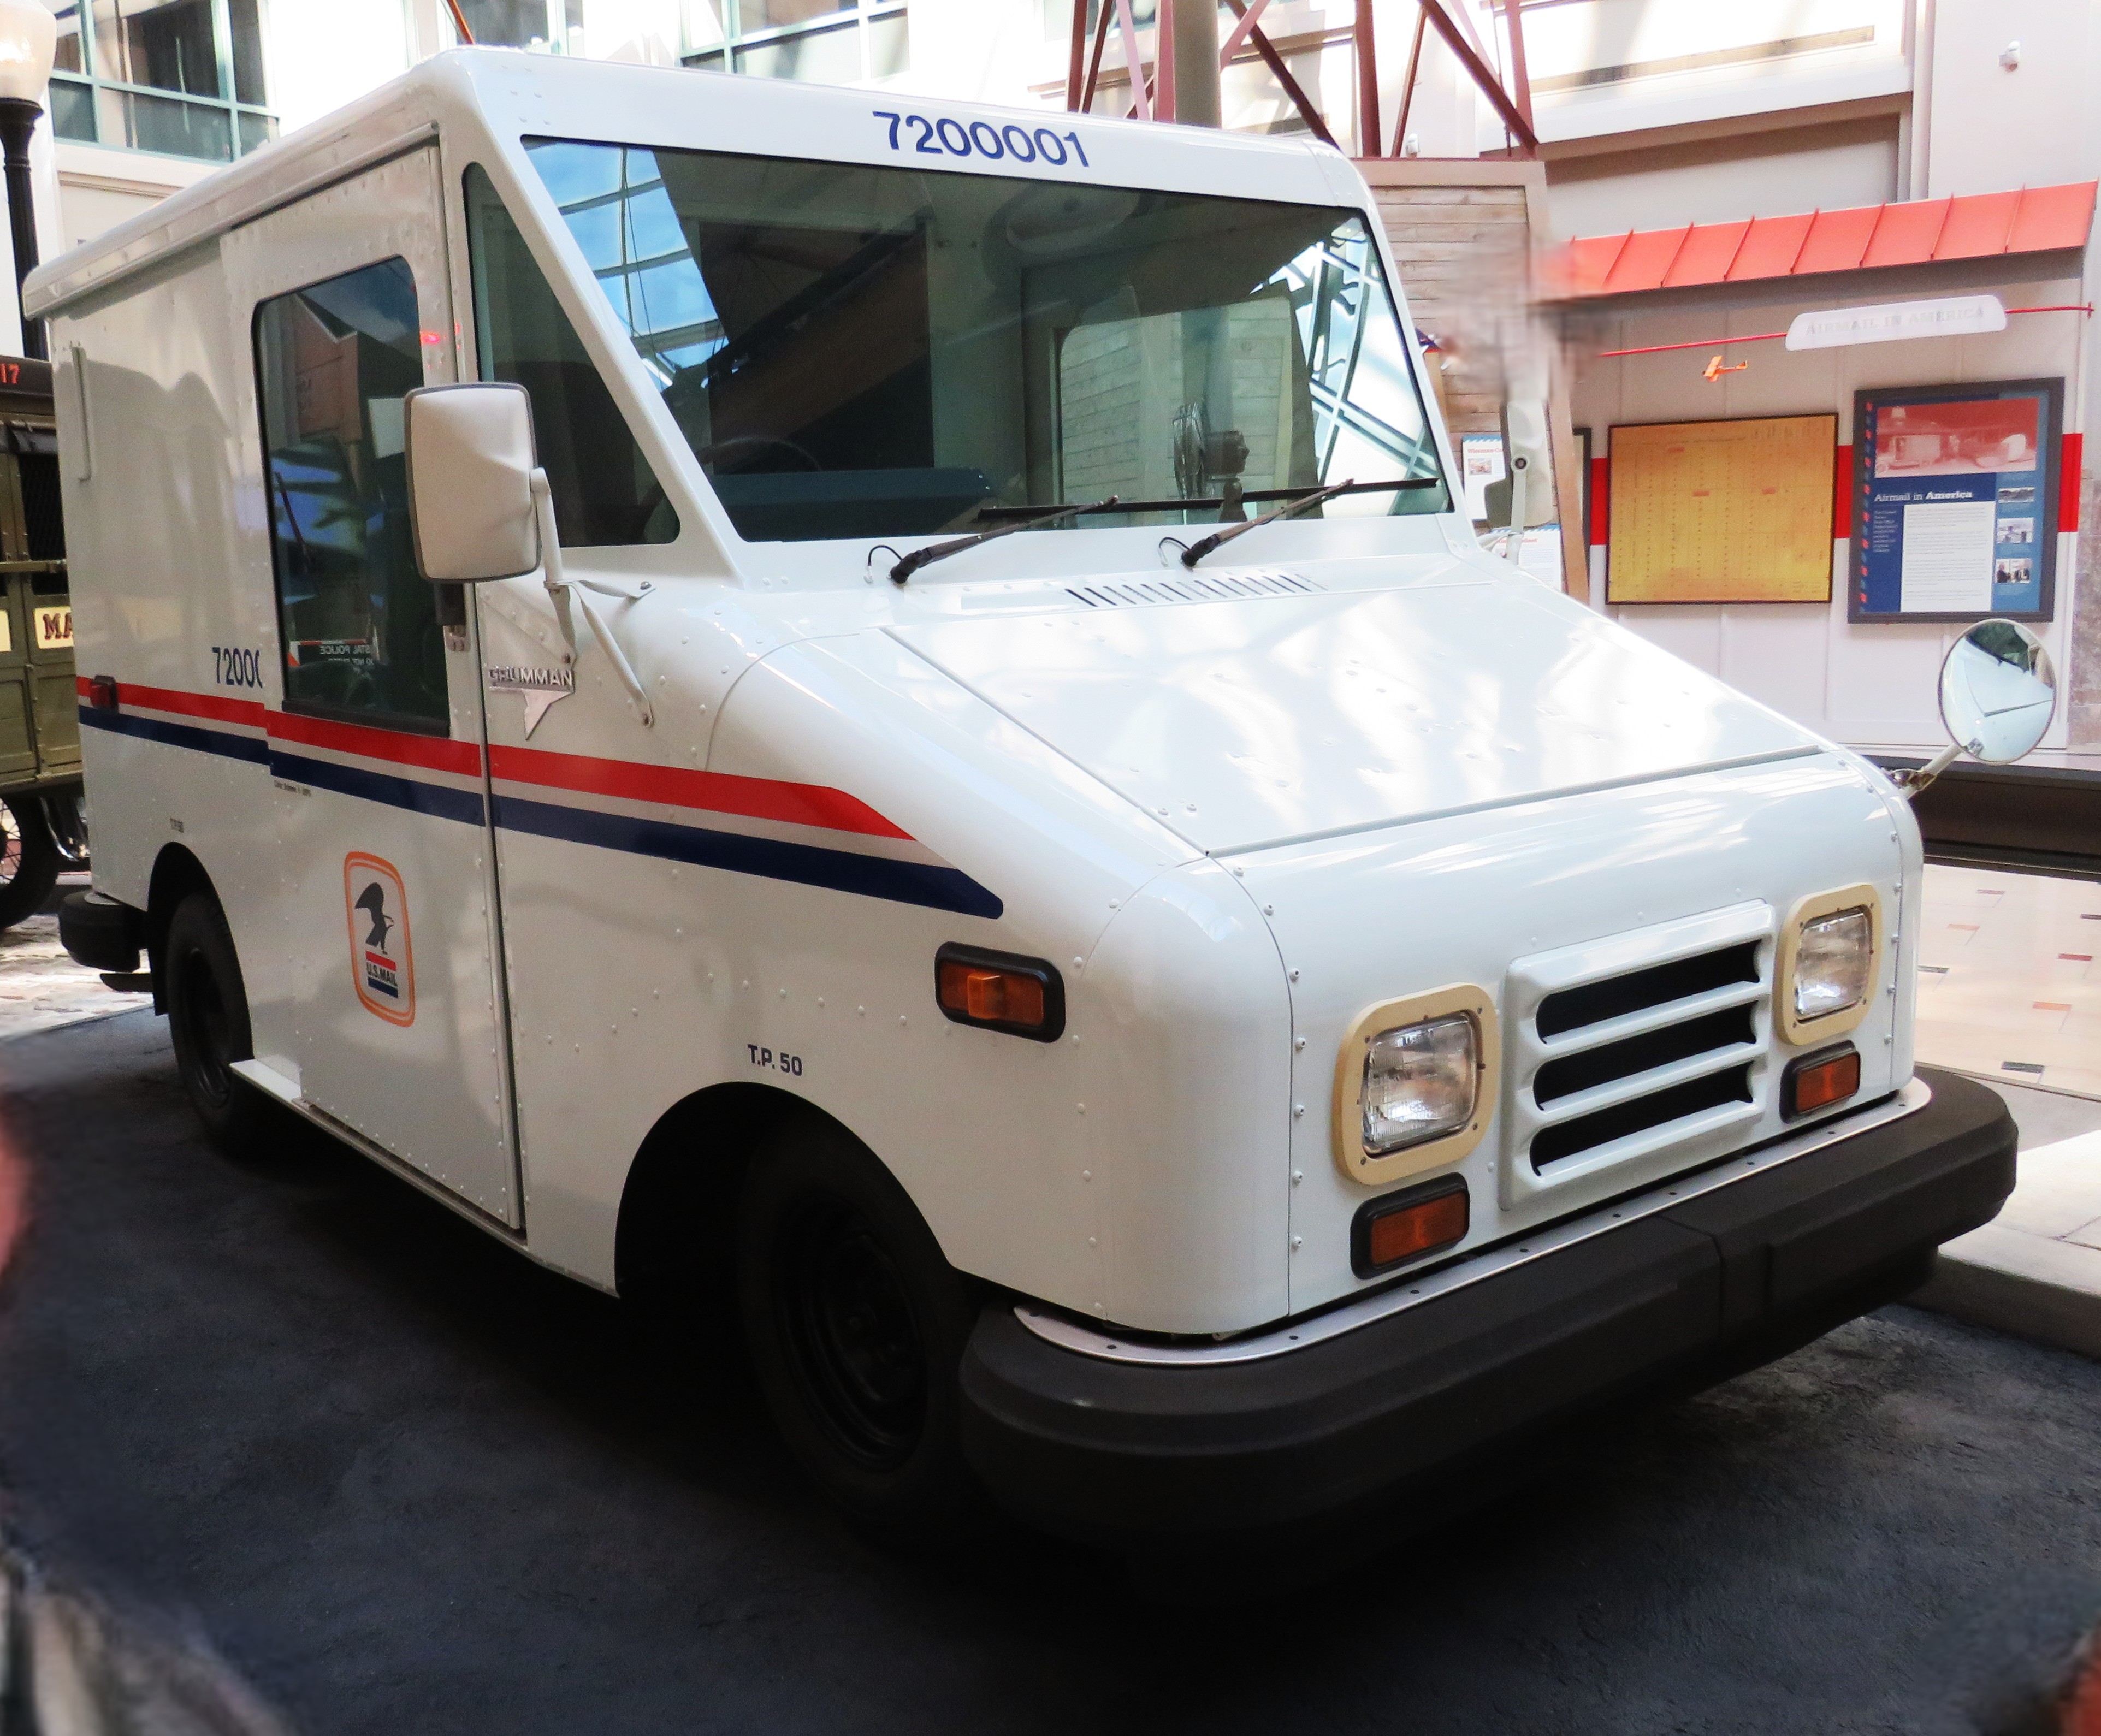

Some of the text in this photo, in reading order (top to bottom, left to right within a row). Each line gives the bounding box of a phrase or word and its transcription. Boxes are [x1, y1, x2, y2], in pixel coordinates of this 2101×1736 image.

[872, 111, 1089, 167] 7200001
[1806, 304, 1984, 335] AIRMAIL IN AMERICA
[1874, 493, 1911, 502] Airmail
[1925, 491, 1973, 500] America
[747, 1044, 802, 1076] T.P. 50
